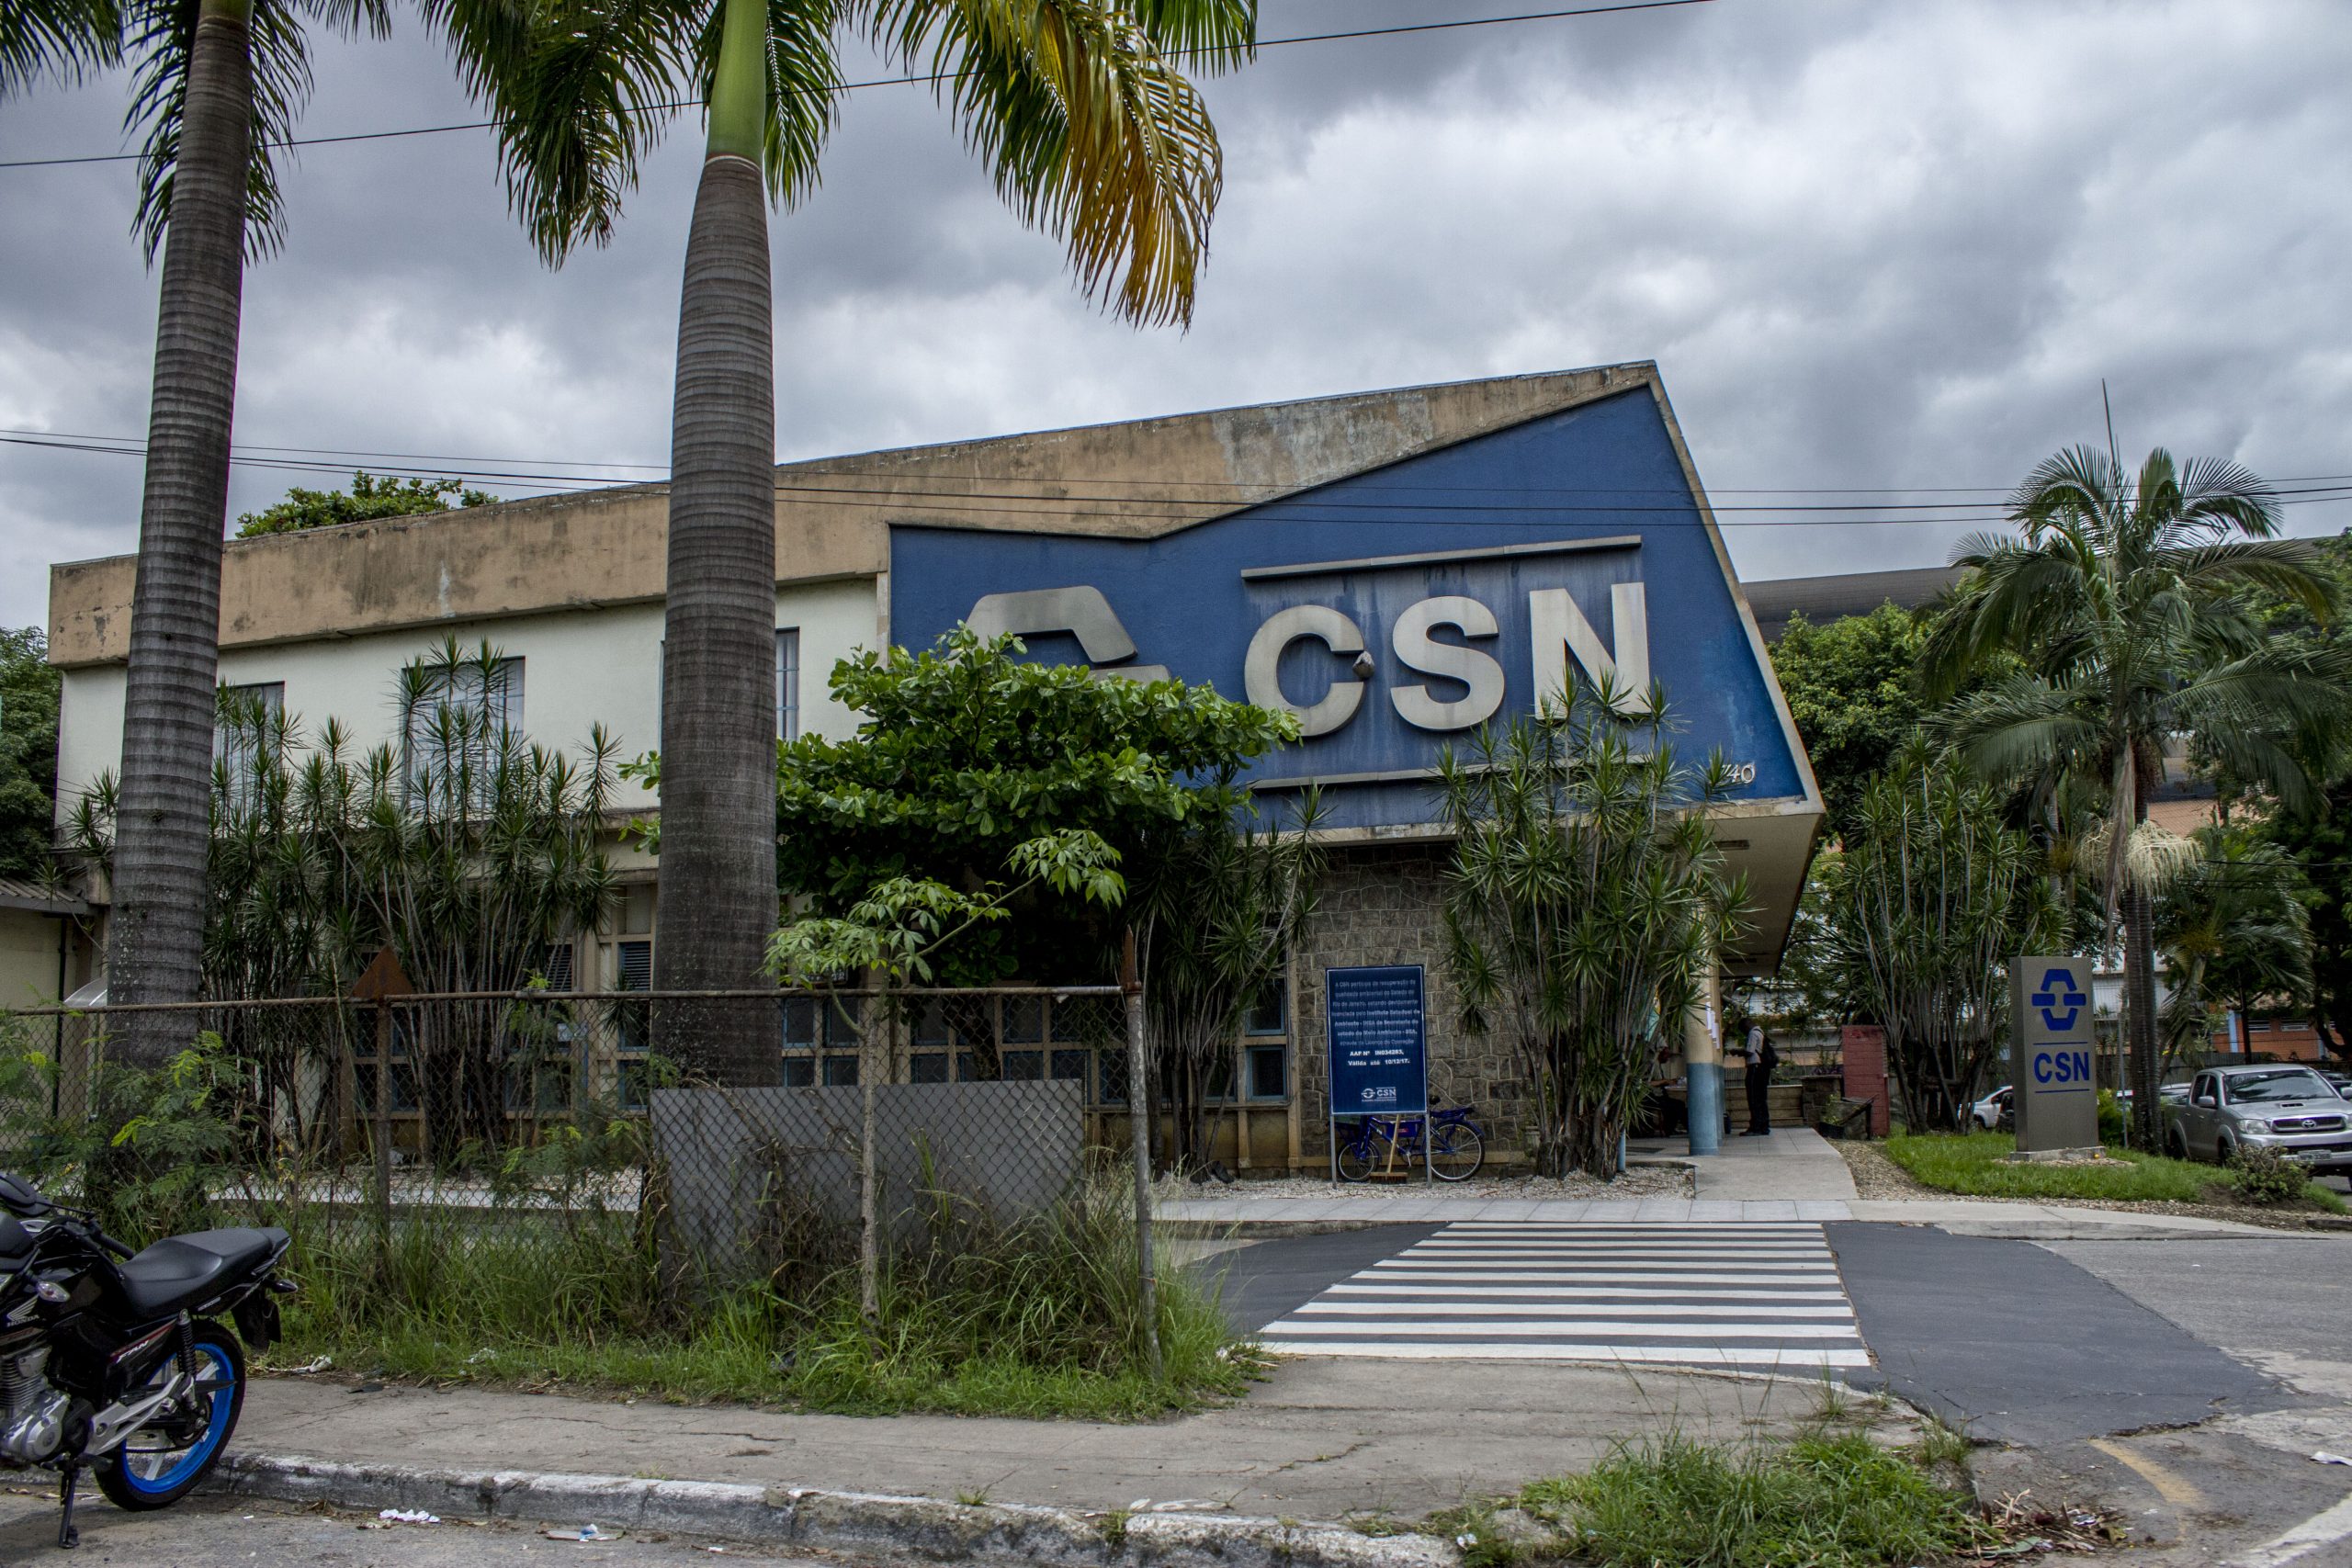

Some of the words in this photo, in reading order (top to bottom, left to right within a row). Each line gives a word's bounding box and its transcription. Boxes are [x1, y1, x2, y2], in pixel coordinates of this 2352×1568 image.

[1243, 581, 1652, 737] CSN
[2033, 1052, 2090, 1084] CSN
[1376, 1089, 1396, 1097] CSN
[6, 1314, 40, 1327] HONDA
[116, 1339, 149, 1364] FAN
